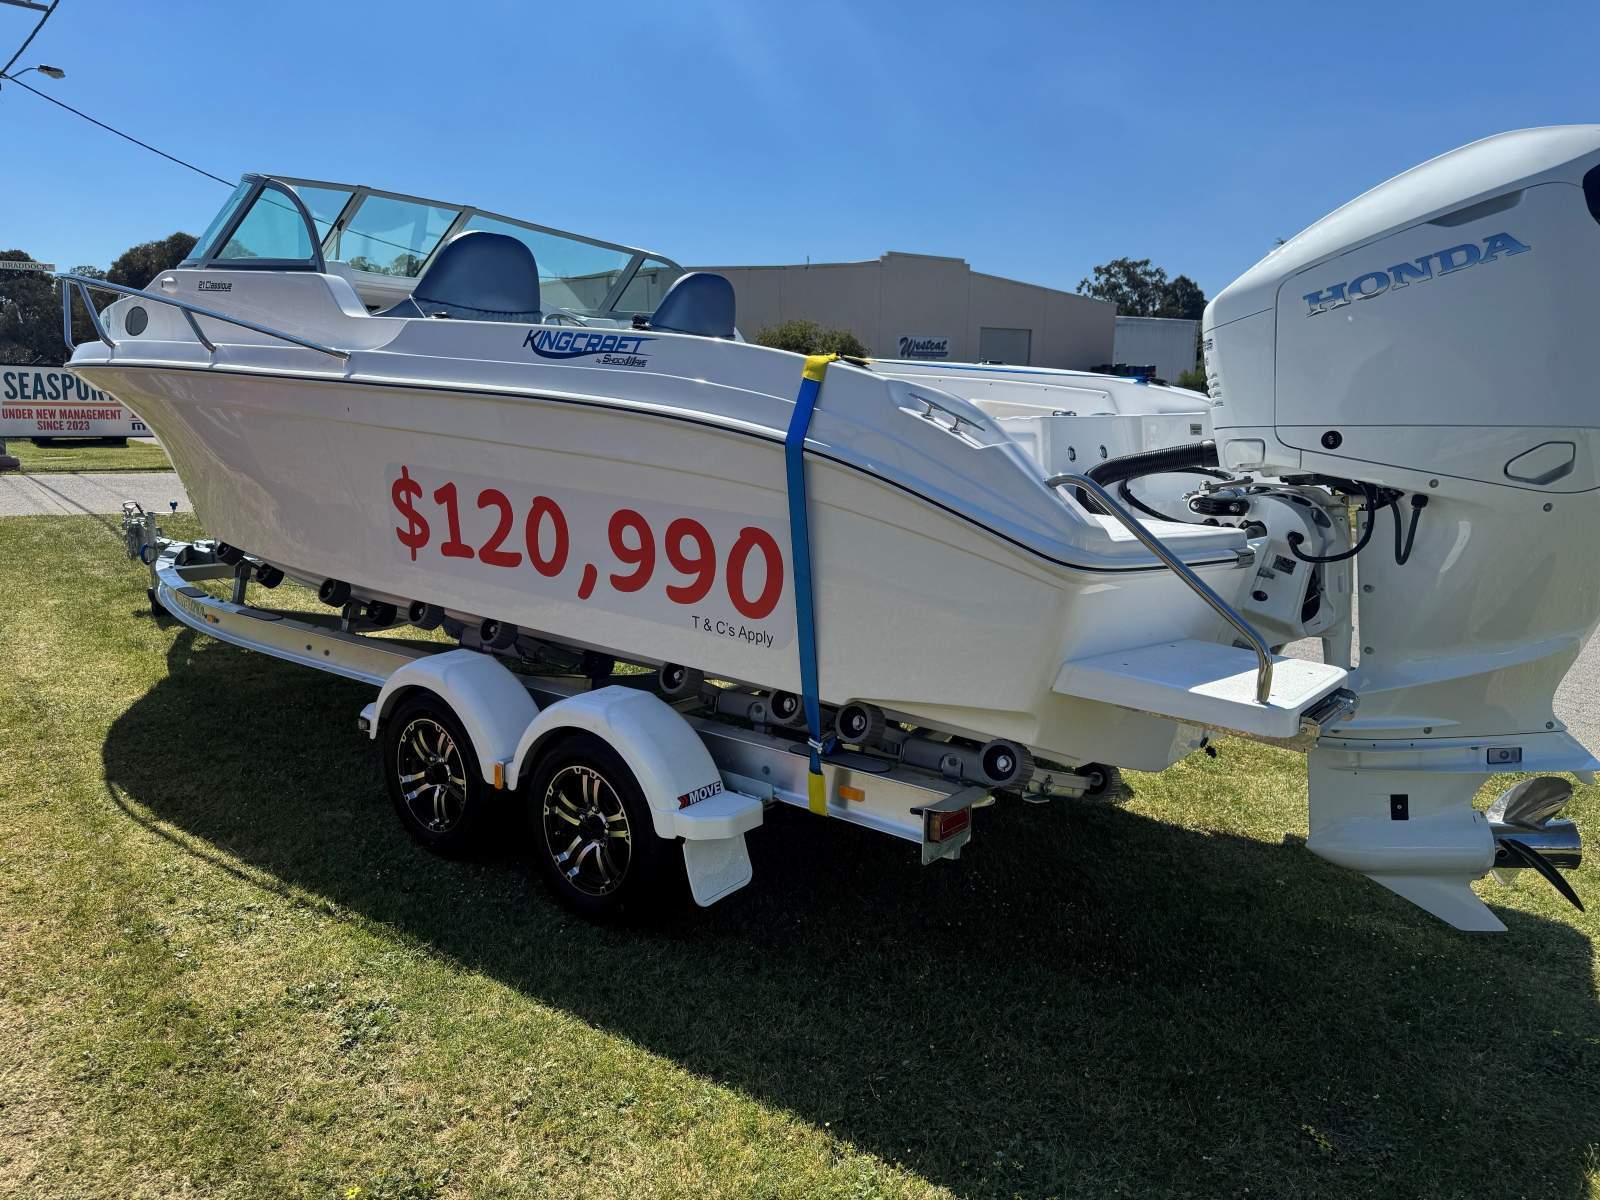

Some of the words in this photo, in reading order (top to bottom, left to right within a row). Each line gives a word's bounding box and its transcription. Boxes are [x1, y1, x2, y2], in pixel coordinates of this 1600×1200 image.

[1303, 232, 1531, 317] HONDA
[523, 329, 658, 358] KINGCRAFT
[899, 337, 949, 357] Westcat
[2, 408, 33, 419] UNDER
[36, 409, 57, 419] NEW
[60, 409, 122, 420] MANAGEMENT
[37, 420, 64, 430] SINCE
[66, 421, 90, 431] 2023
[391, 465, 784, 620] $120,990
[692, 615, 700, 629] T
[703, 618, 712, 632] &
[716, 621, 735, 637] C's
[738, 625, 774, 648] Apply
